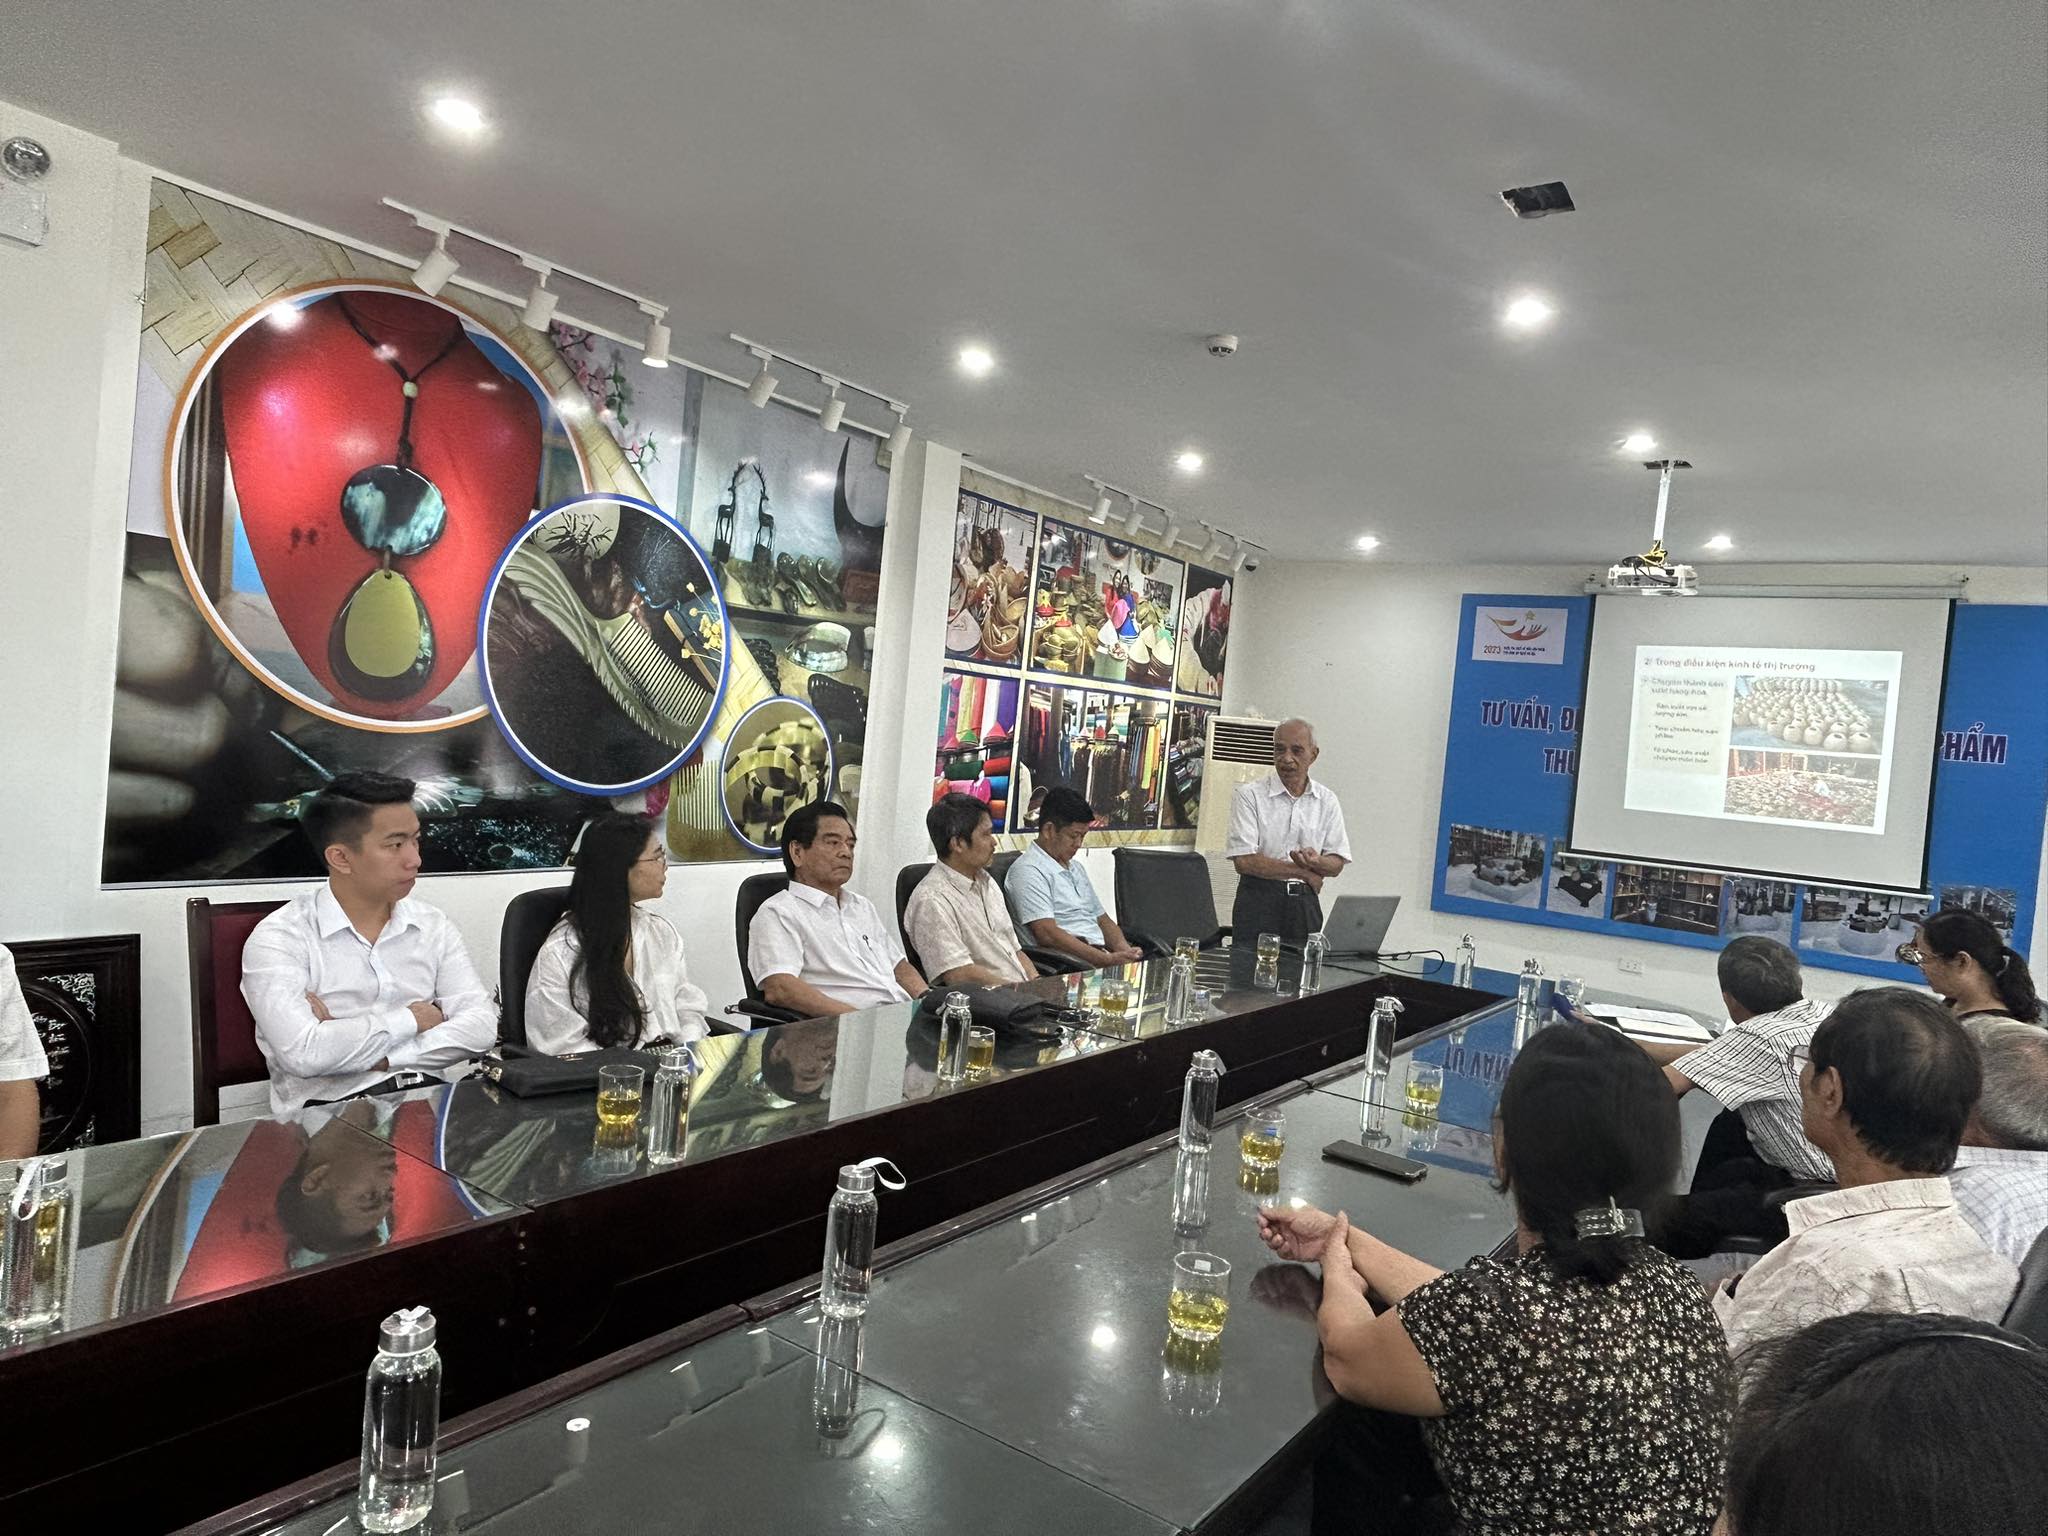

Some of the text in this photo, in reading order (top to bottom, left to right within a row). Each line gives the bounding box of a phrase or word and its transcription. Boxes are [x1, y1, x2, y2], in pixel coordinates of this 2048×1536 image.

[1728, 660, 1750, 669] kinh
[1481, 699, 1508, 727] TƯ
[1509, 695, 1555, 735] VẤN,
[1941, 721, 2008, 765] HẨM
